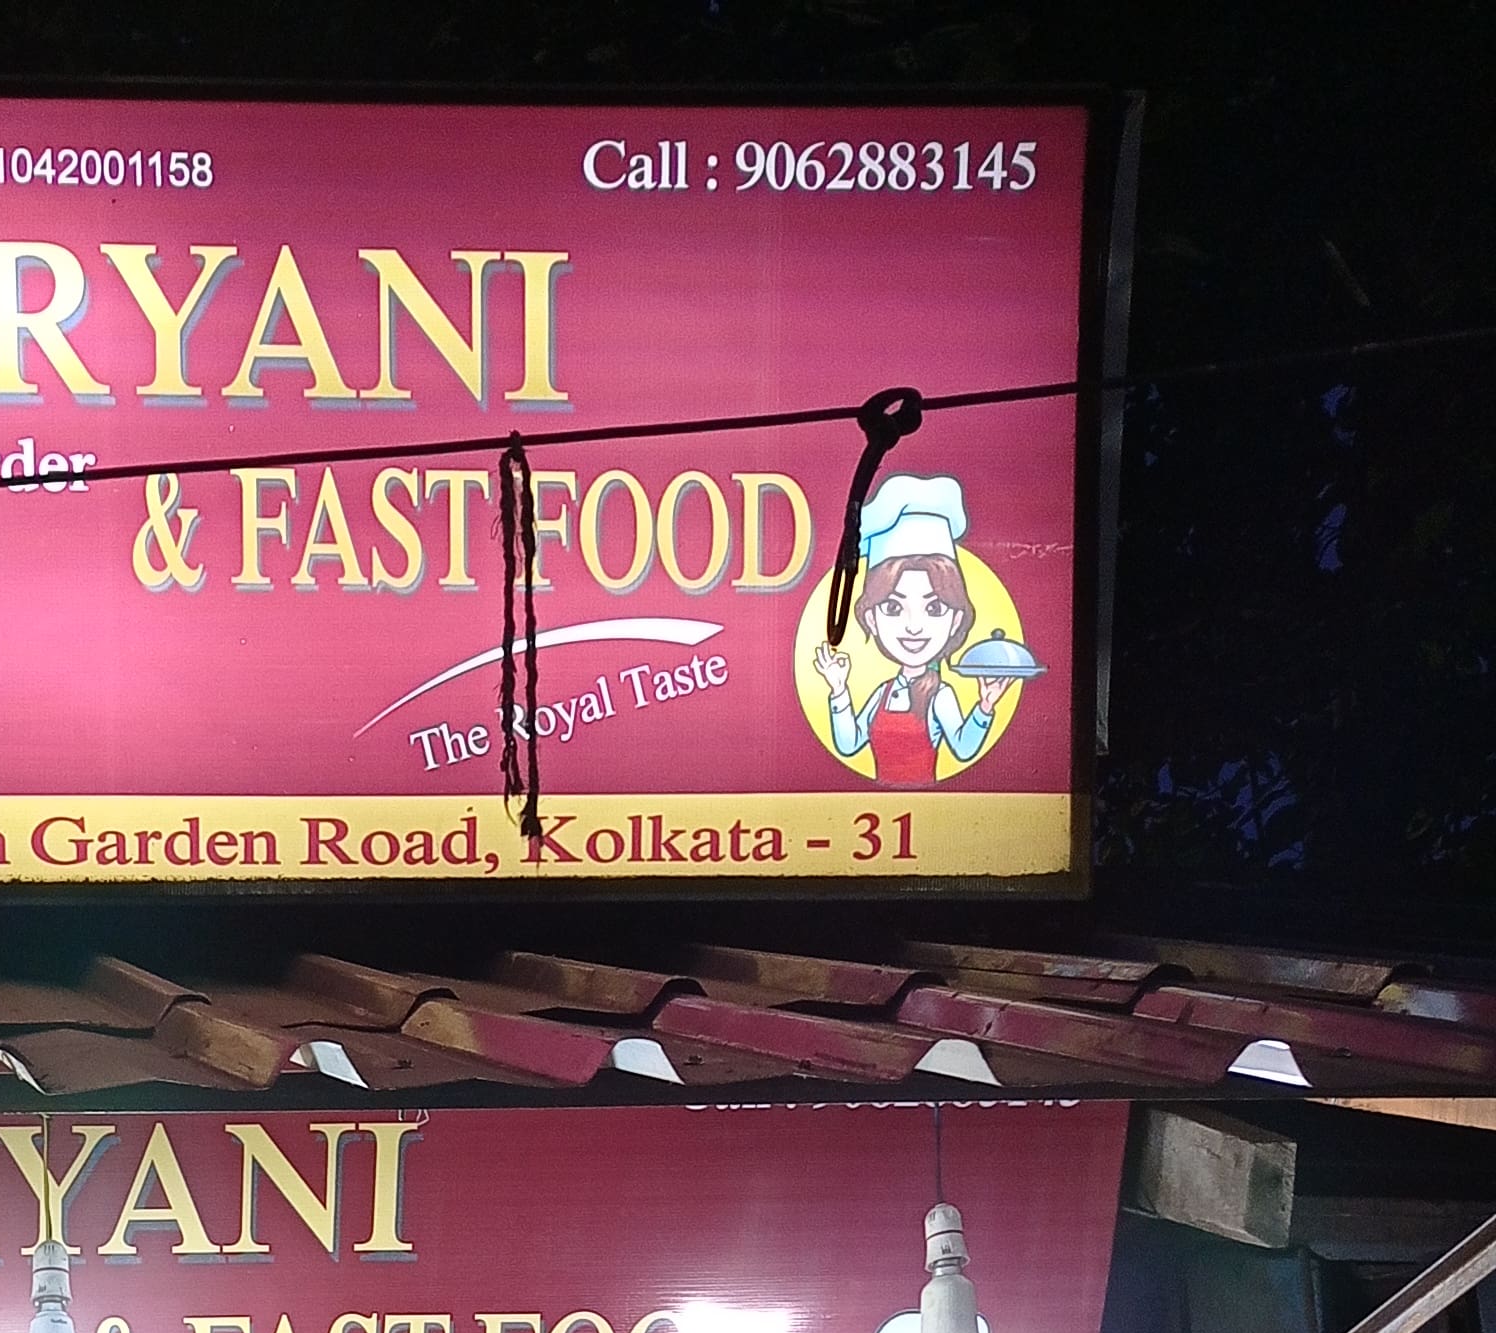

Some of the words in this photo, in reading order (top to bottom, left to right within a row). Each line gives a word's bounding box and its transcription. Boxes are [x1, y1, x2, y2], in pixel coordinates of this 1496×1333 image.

[582, 139, 689, 194] Call
[734, 139, 1038, 196] 9062883145
[130, 472, 207, 596] &
[228, 465, 502, 598] FAST
[520, 469, 814, 598] FOOD
[408, 721, 491, 772] The
[619, 653, 730, 710] Taste
[32, 814, 281, 870] Garden
[298, 811, 501, 877] Road,
[520, 808, 784, 865] Kolkata
[850, 812, 921, 865] 31
